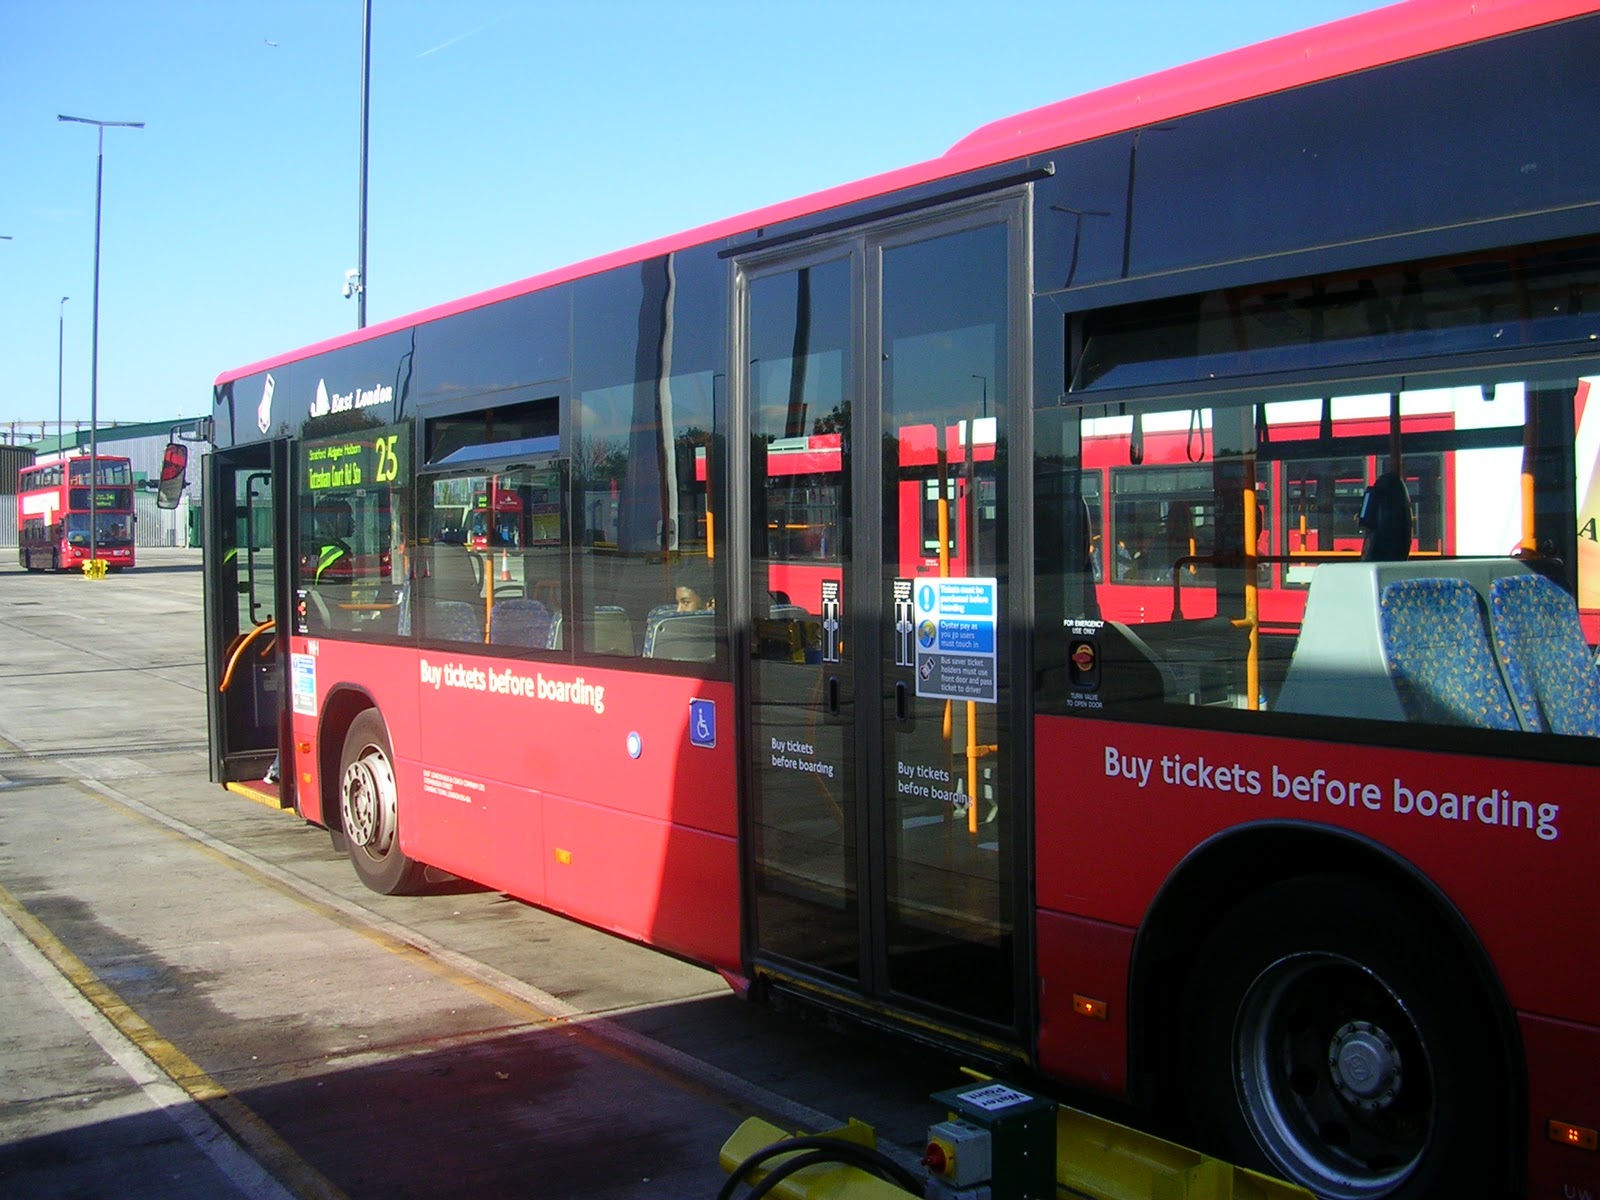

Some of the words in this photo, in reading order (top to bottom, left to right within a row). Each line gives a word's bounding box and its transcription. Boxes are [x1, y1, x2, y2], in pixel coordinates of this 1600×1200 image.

[331, 391, 353, 414] East
[355, 383, 393, 407] London
[375, 435, 398, 482] 25
[941, 621, 960, 631] Oyster
[960, 623, 970, 631] pay
[1063, 619, 1074, 627] FOR
[1075, 620, 1104, 628] EMERGENCY
[941, 656, 951, 664] Bus
[967, 659, 984, 667] ticket
[941, 666, 961, 675] holders
[420, 659, 442, 690] Buy
[444, 662, 487, 691] tickets
[489, 667, 535, 698] before
[537, 673, 605, 714] boarding
[941, 675, 955, 683] front
[955, 676, 968, 684] door
[941, 683, 957, 692] ticket
[965, 685, 981, 693] driver
[1074, 700, 1088, 708] OPEN
[771, 737, 786, 753] Buy
[787, 740, 814, 755] tickets
[771, 754, 797, 770] before
[798, 758, 834, 778] boarding
[898, 761, 914, 779] Buy
[916, 765, 950, 783] tickets
[898, 780, 929, 798] before
[931, 786, 973, 807] boarding
[1104, 746, 1153, 788] Buy
[1161, 753, 1261, 795] tickets
[1272, 765, 1381, 810] before
[1393, 779, 1559, 841] boarding
[983, 1093, 1024, 1106] Water
